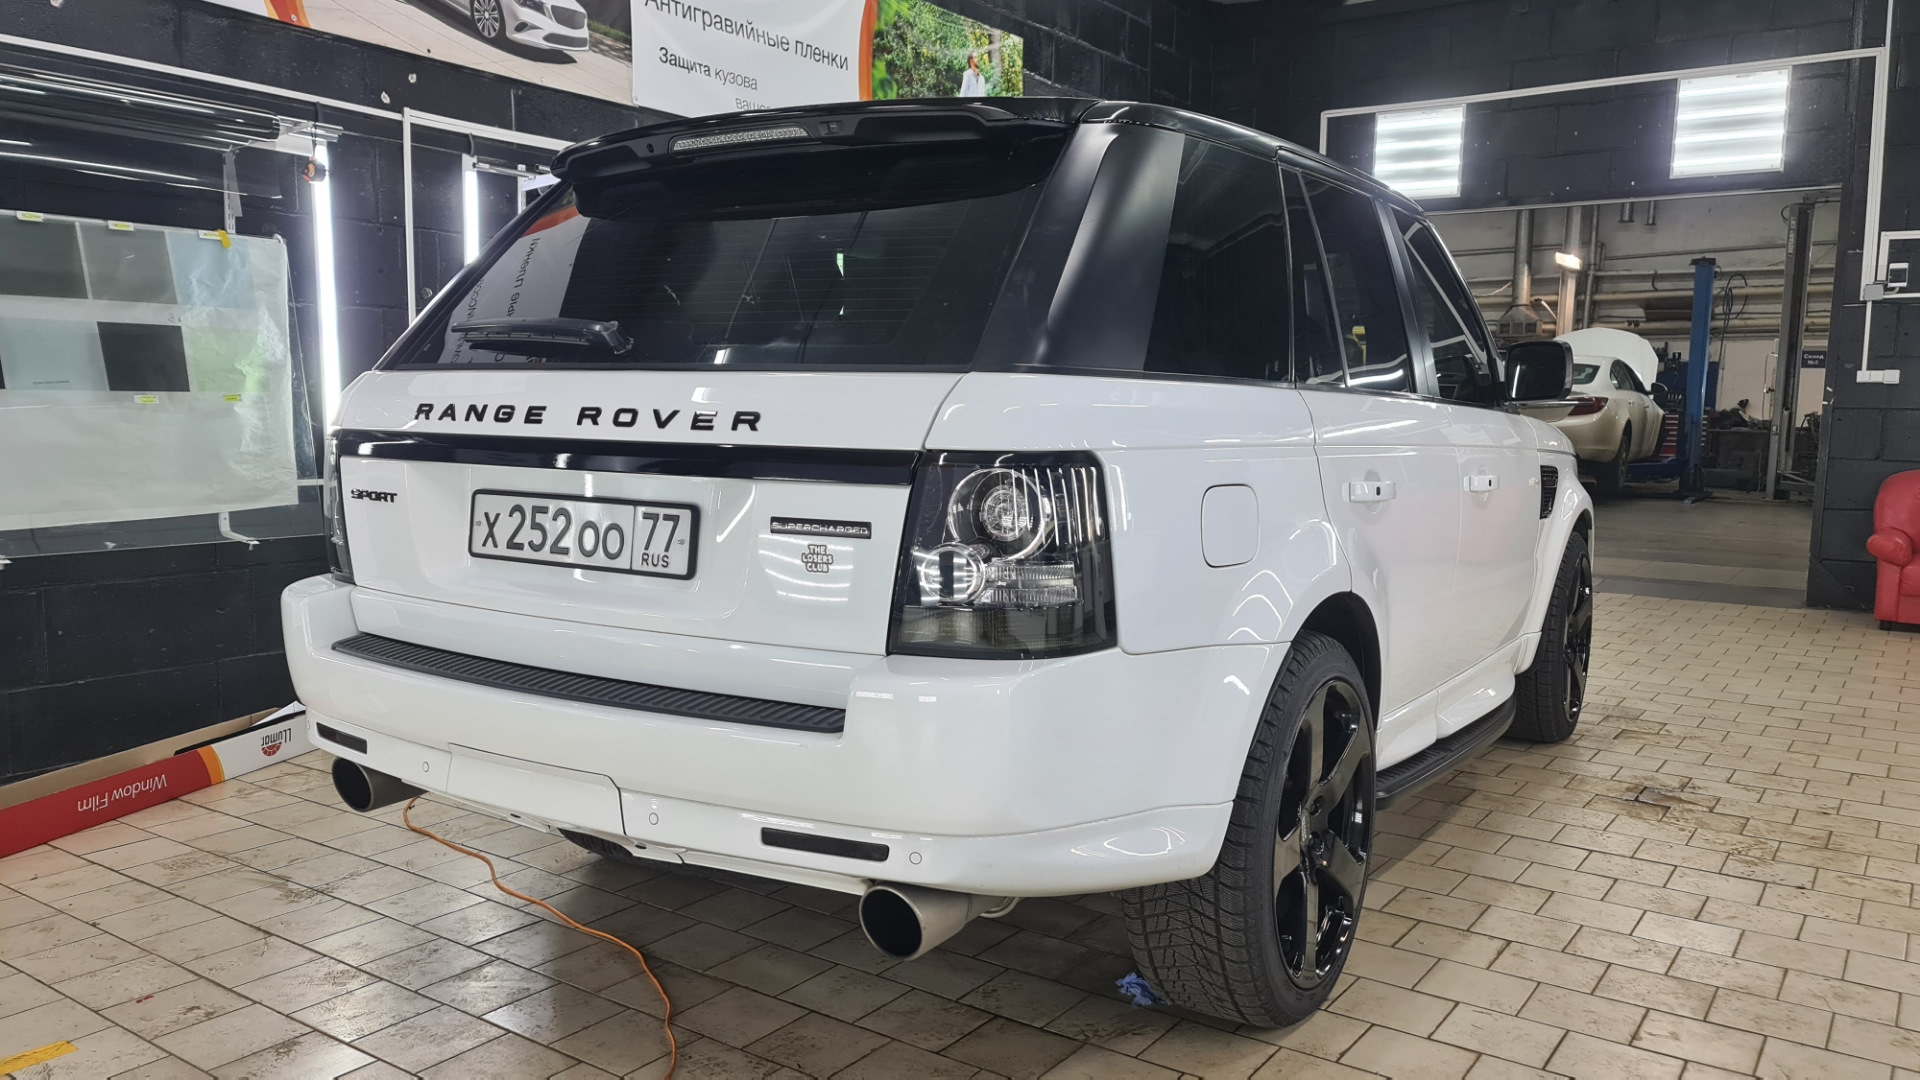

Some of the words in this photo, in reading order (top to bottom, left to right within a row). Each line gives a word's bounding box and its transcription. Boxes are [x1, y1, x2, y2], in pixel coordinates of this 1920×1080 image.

[795, 39, 849, 71] пленки
[659, 46, 711, 77] Защита
[714, 67, 758, 90] кузова
[414, 403, 548, 425] RANGE
[576, 406, 762, 431] ROVER
[350, 488, 398, 503] SPORT
[642, 512, 681, 553] 77
[771, 521, 869, 535] SUPERCHARGED
[801, 553, 833, 564] LOSERS
[807, 544, 827, 554] THE
[640, 552, 671, 569] RUS
[806, 563, 829, 573] CLUB
[260, 727, 292, 747] LLumar
[111, 774, 167, 801] Window
[77, 792, 109, 812] Film
